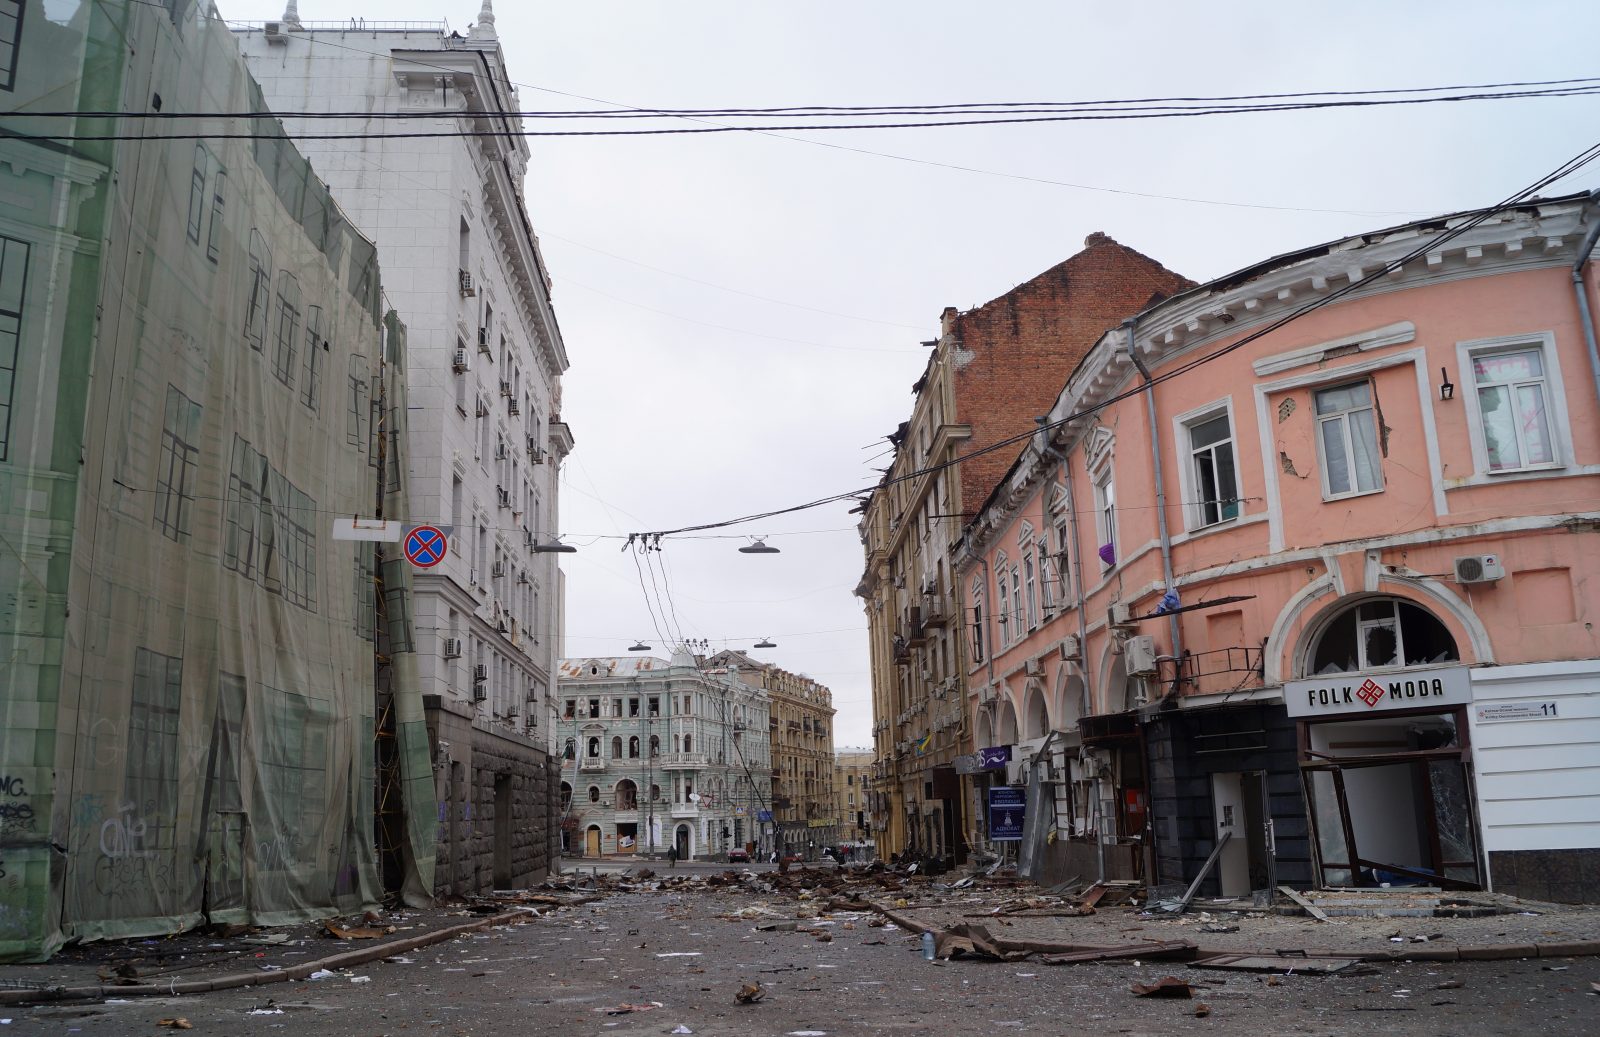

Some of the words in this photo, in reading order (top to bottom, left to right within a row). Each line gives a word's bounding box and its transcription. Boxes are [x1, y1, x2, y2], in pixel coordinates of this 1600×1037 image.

[1308, 686, 1353, 706] FOLK
[1389, 678, 1443, 699] MODA
[1540, 703, 1557, 716] 11
